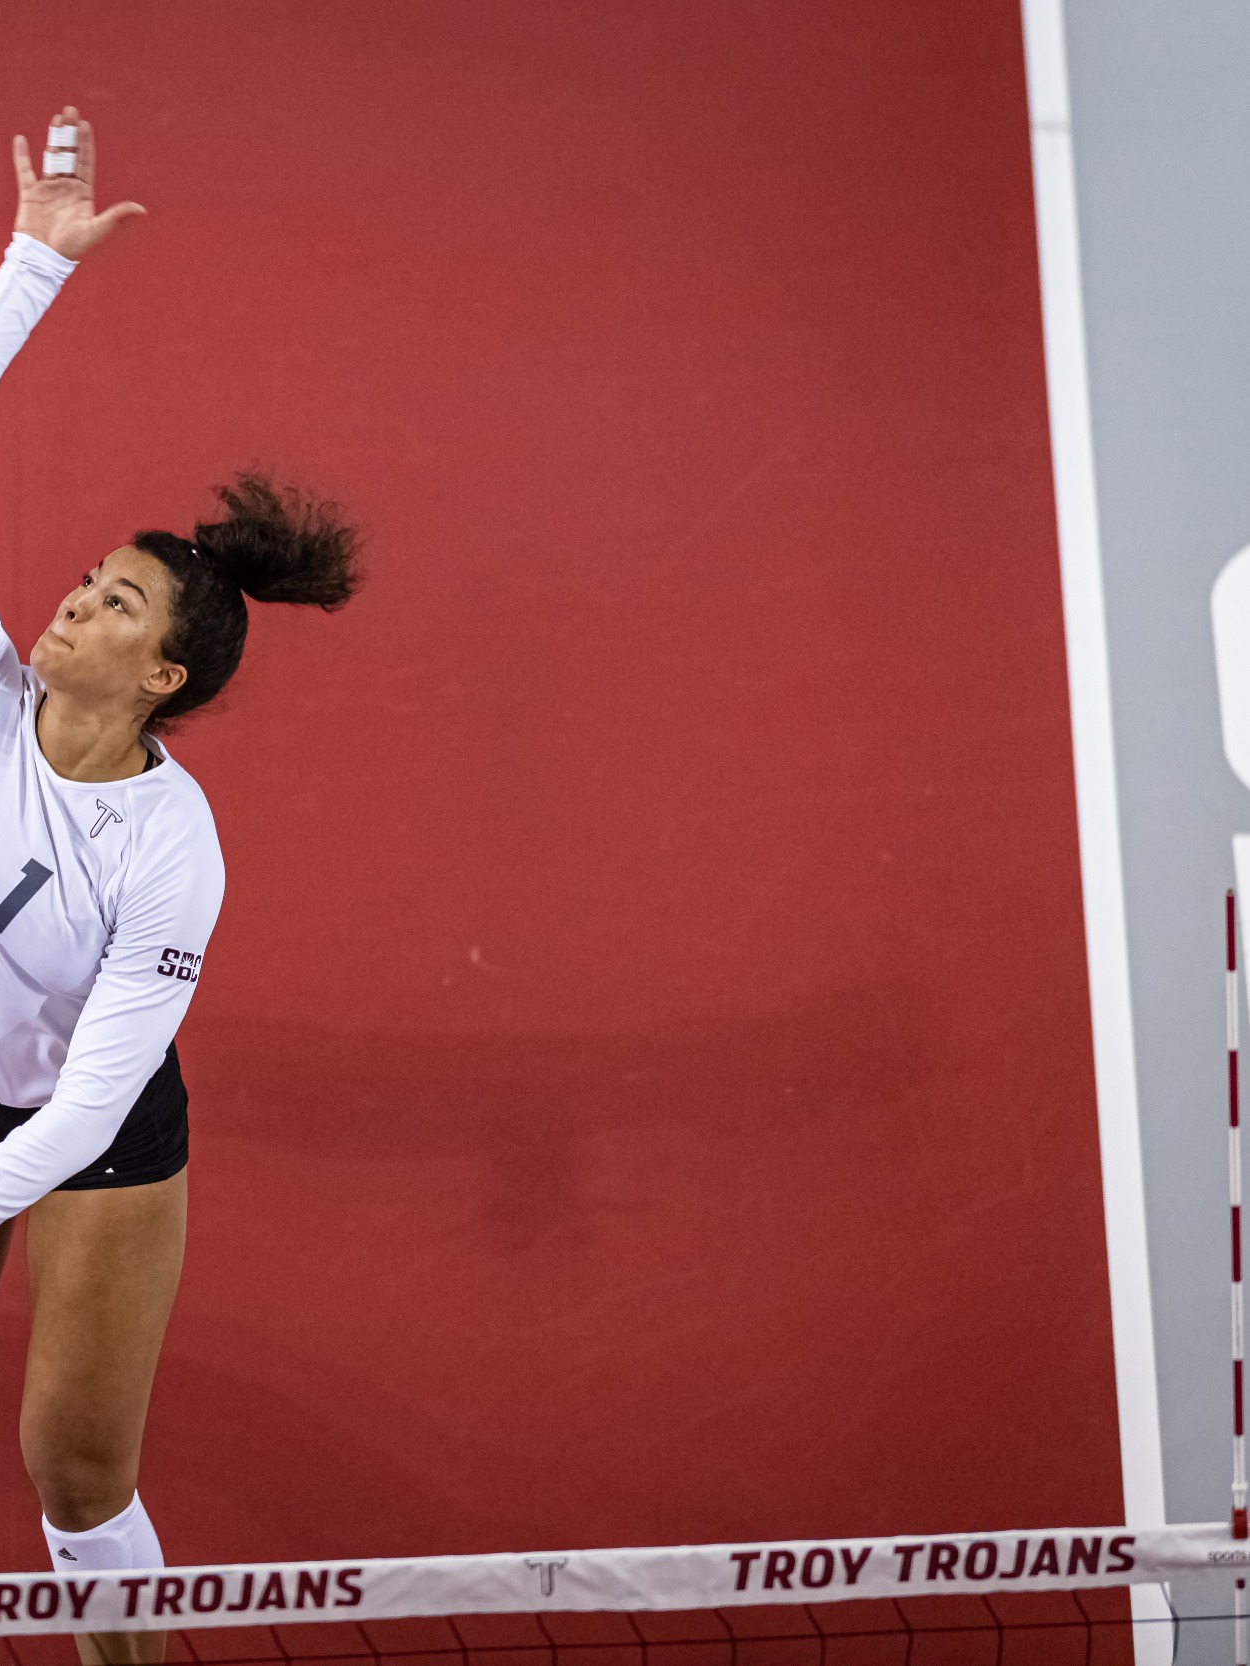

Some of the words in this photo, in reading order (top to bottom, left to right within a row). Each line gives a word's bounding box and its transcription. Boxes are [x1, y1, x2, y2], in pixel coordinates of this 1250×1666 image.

[730, 1546, 873, 1592] TROY
[894, 1536, 1137, 1583] TROJANS
[118, 1567, 364, 1618] TROJANS
